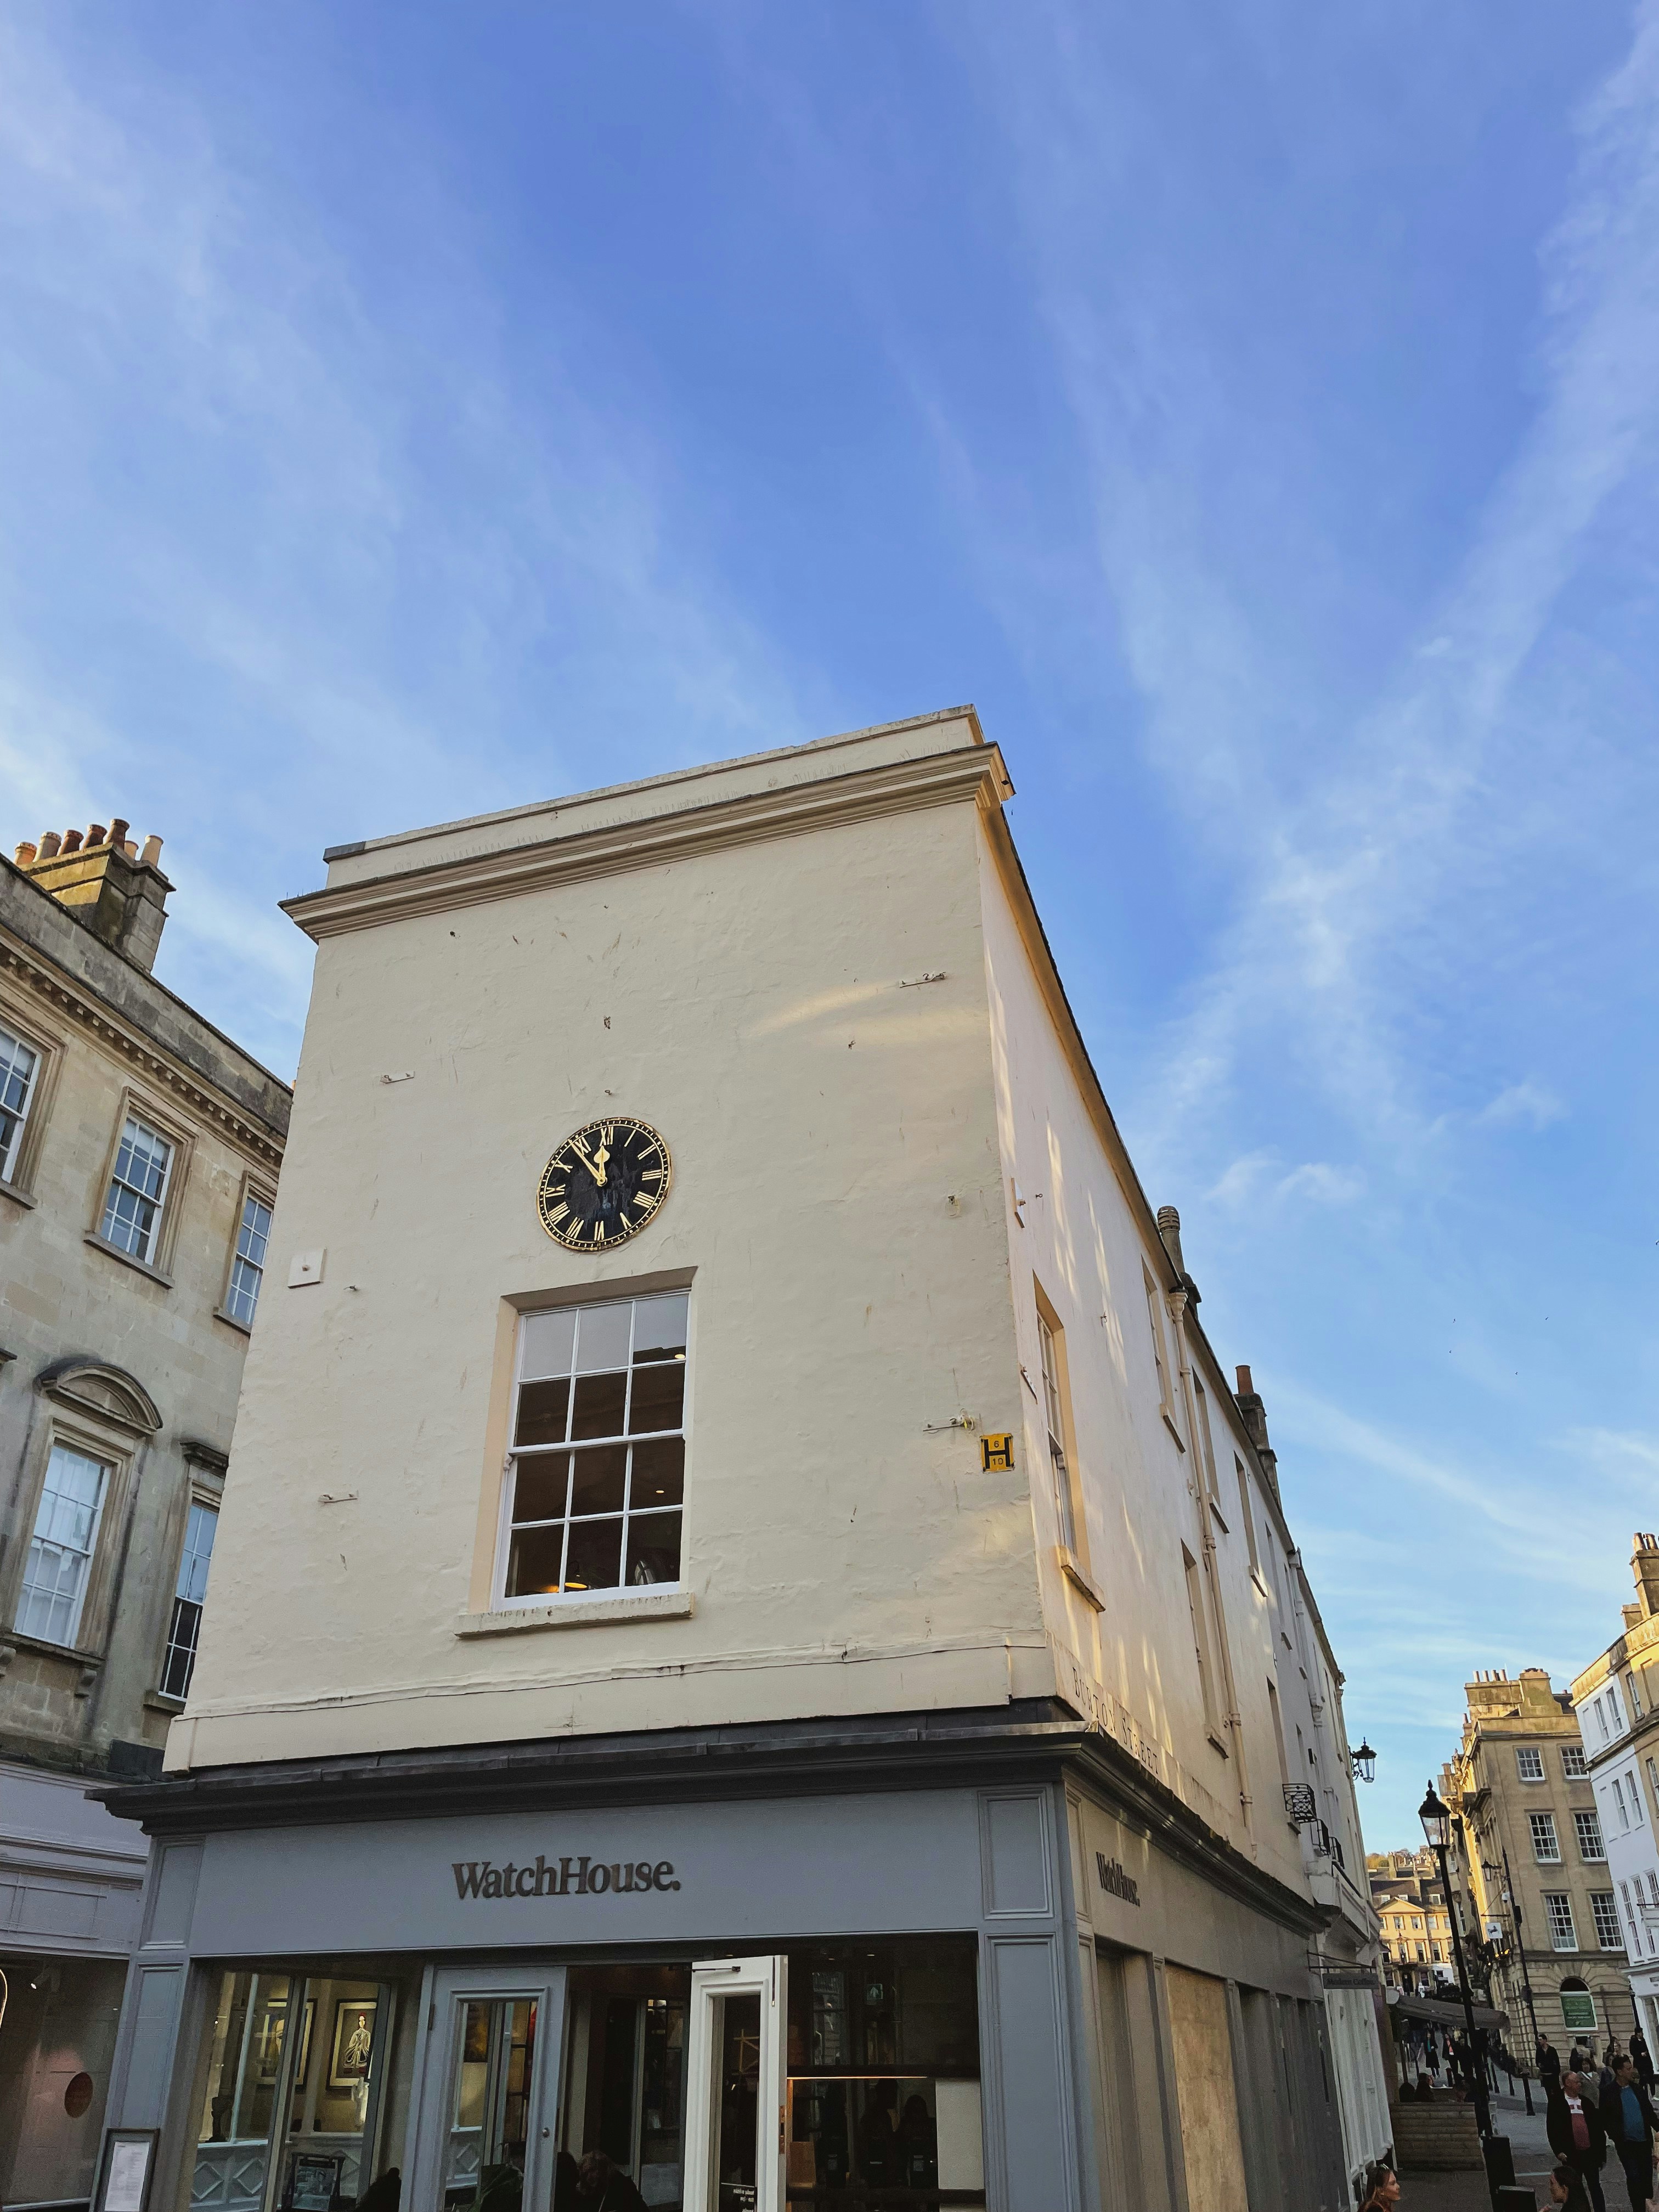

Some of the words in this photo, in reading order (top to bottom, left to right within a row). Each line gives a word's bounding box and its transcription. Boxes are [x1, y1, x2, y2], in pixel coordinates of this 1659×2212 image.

[575, 1136, 592, 1156] XI
[599, 1126, 613, 1147] XII
[624, 1129, 636, 1147] I
[637, 1144, 657, 1160] II
[555, 1160, 573, 1173] X
[642, 1169, 662, 1181] III
[546, 1184, 566, 1197] IX
[633, 1190, 656, 1209] IIII
[549, 1201, 570, 1225] VIII
[620, 1212, 632, 1230] V
[566, 1216, 584, 1239] VII
[594, 1220, 605, 1241] VI
[984, 1437, 1011, 1469] H
[1073, 1667, 1116, 1733] BURTON
[1122, 1718, 1158, 1774] STREET
[452, 1855, 681, 1899] WatchHouse.
[1096, 1852, 1140, 1907] WatchHouse.
